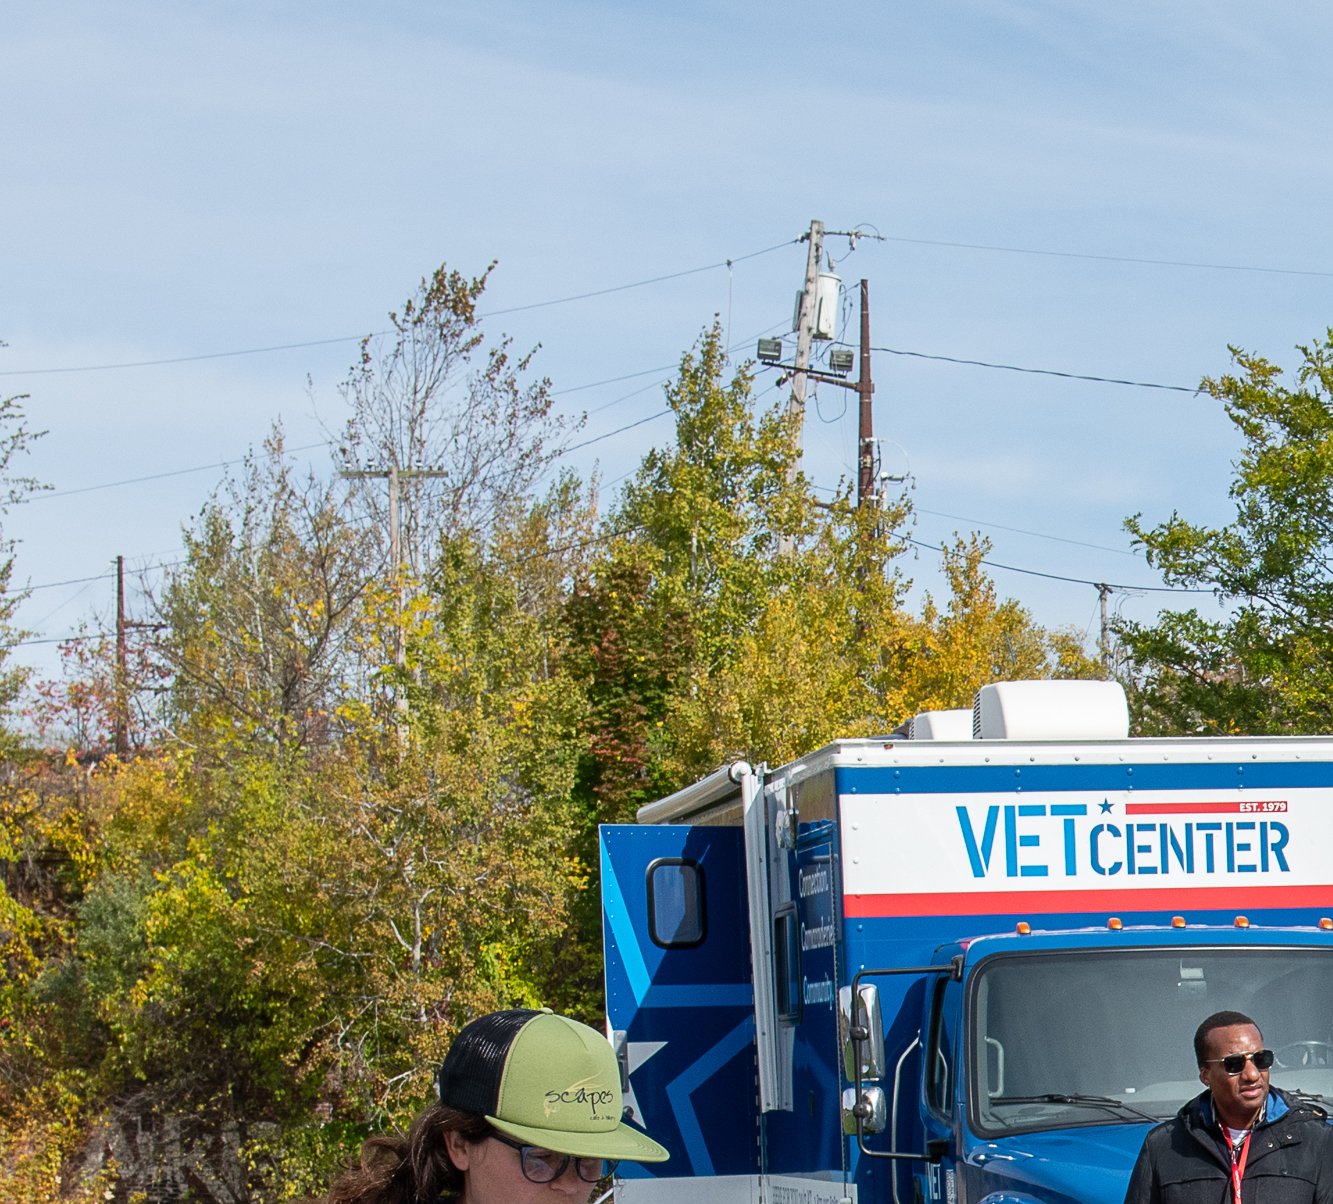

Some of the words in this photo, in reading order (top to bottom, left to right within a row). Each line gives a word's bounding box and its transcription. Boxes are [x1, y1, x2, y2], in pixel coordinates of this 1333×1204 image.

[1240, 802, 1261, 812] EST.
[1262, 802, 1287, 812] 1979
[955, 804, 1087, 878] VET
[1090, 821, 1290, 876] CENTER
